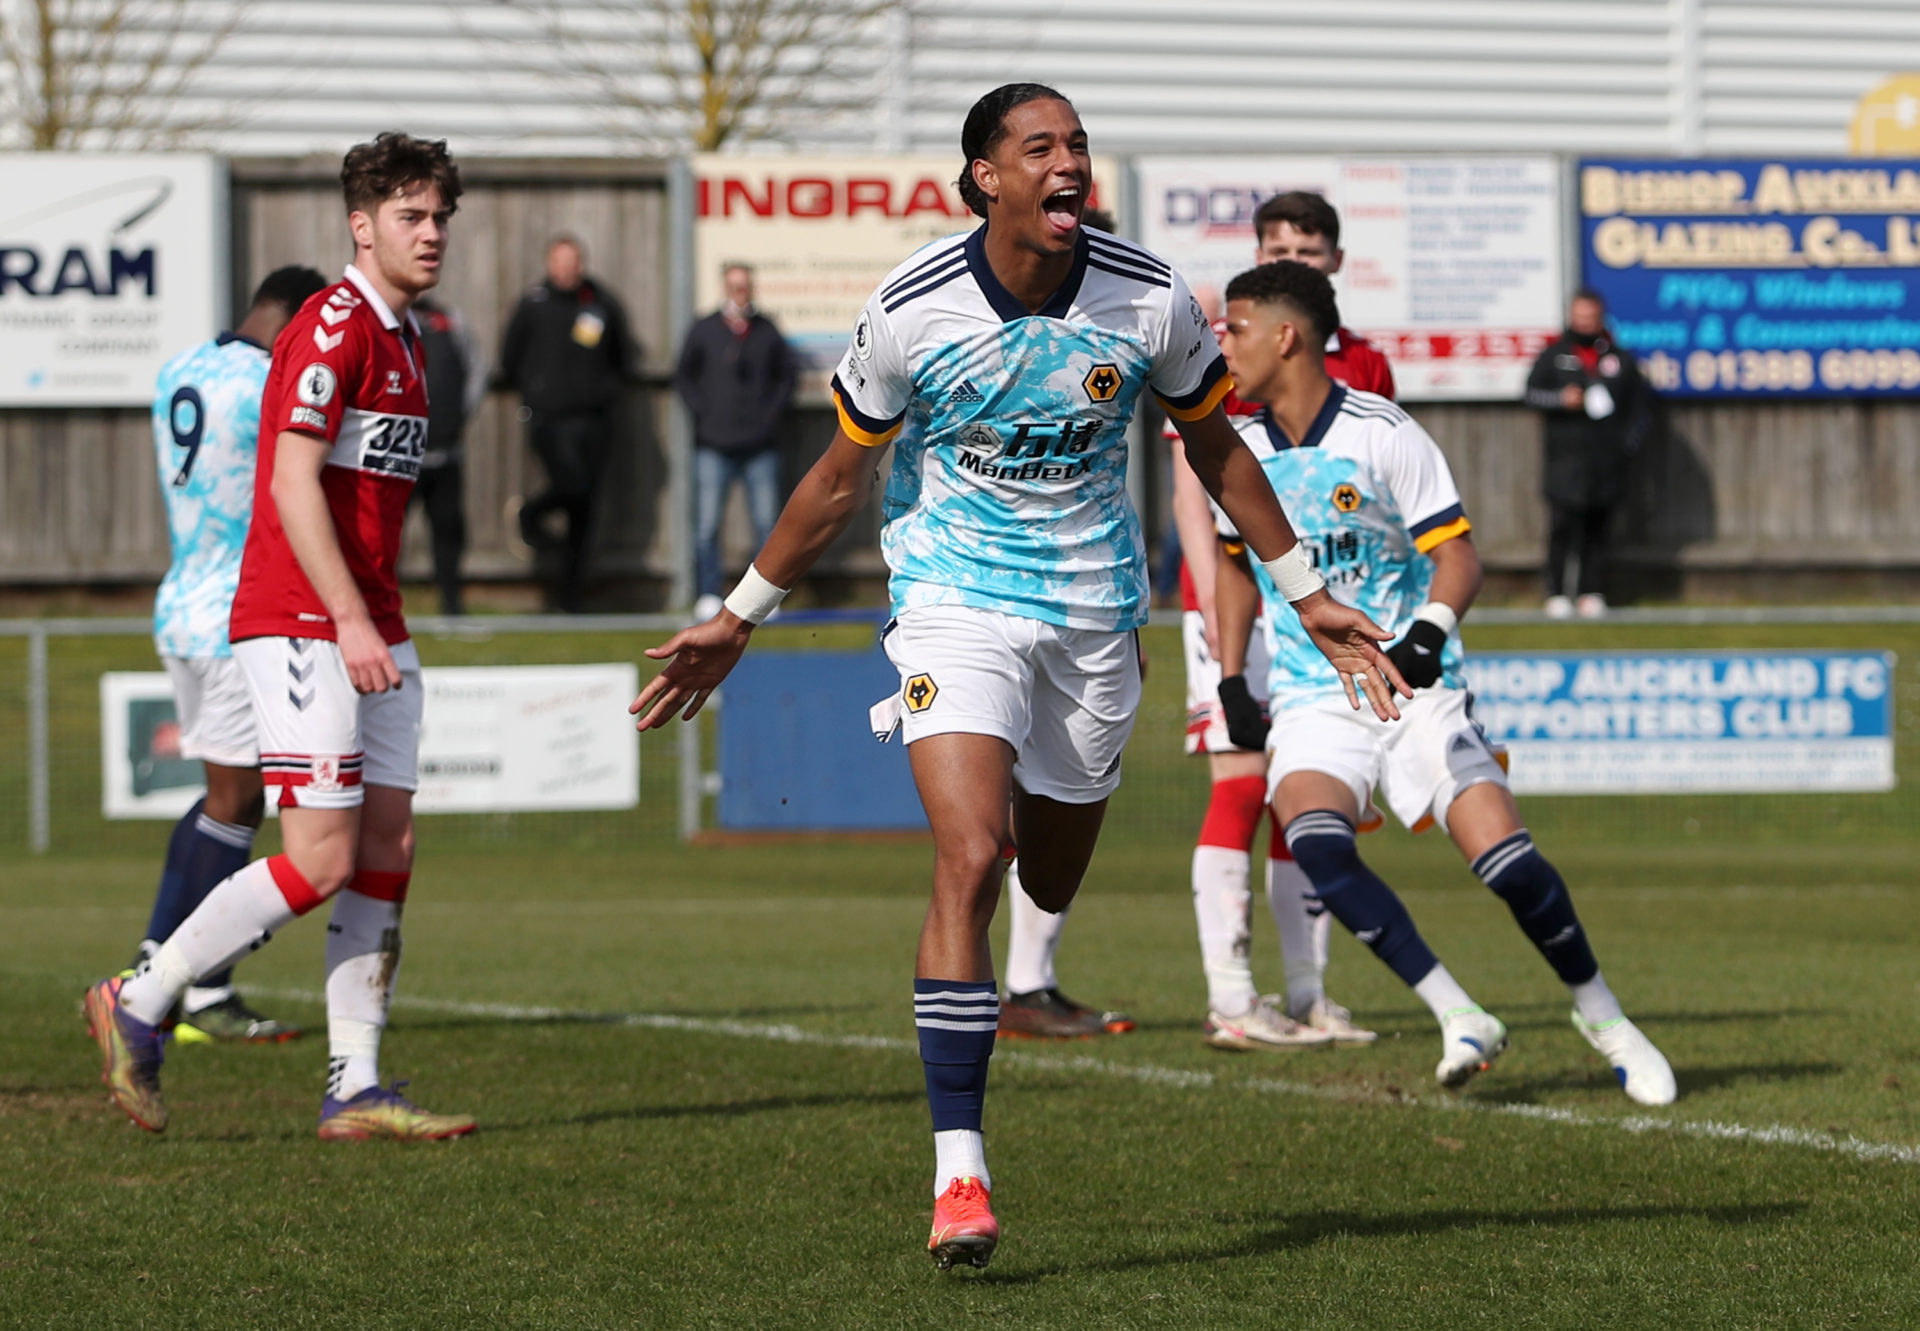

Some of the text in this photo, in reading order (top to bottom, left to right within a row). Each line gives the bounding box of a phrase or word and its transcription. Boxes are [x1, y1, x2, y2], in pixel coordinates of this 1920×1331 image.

[697, 179, 970, 217] INGRA
[1582, 166, 1746, 214] BISHOP
[1593, 217, 1793, 266] GLAZING
[949, 394, 985, 402] adidas
[170, 386, 204, 486] 9
[1005, 419, 1103, 458] 万博
[958, 451, 1094, 480] ManBetX
[1571, 658, 1818, 699] AUCKLAND
[1826, 657, 1887, 699] FC
[1732, 700, 1854, 736] CLUB
